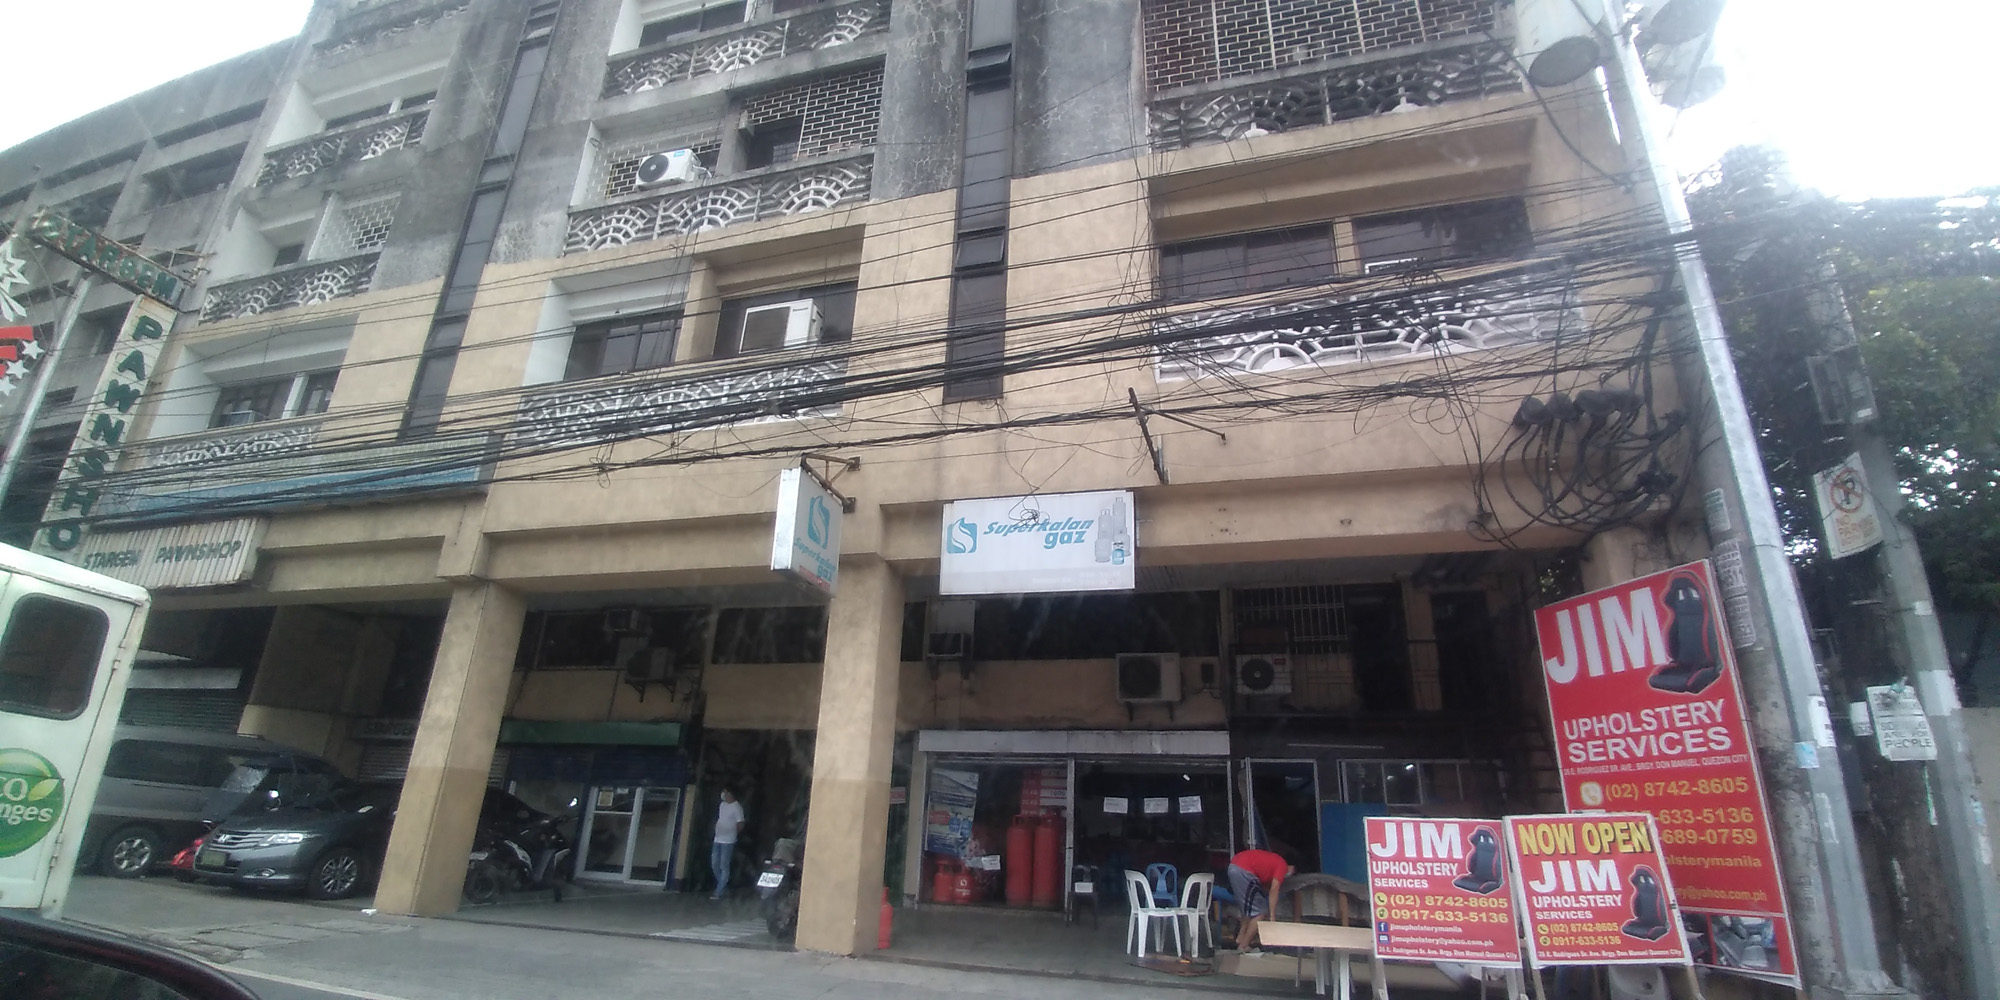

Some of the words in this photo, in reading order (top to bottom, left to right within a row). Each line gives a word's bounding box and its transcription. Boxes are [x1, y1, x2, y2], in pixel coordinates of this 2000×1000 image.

[49, 314, 163, 550] PAWNSHO
[983, 516, 1095, 537] Superkalan
[1043, 528, 1087, 550] gaz
[155, 539, 242, 564] PAWNSHOP
[1545, 586, 1673, 685] JIM
[1562, 698, 1725, 741] UPHOLSTERY
[1568, 726, 1732, 764] SERVICES
[1605, 783, 1639, 801] (02)
[1644, 776, 1749, 797] 8742-8605
[1654, 807, 1754, 825] -633-5136
[1370, 821, 1463, 859] JIM
[1518, 823, 1577, 855] NOW
[1581, 821, 1655, 855] OPEN
[1659, 828, 1758, 845] -689-0759
[1372, 860, 1458, 876] UPHOLSTERY
[1528, 859, 1622, 893] JIM
[1374, 878, 1428, 889] SERVICES
[1390, 894, 1421, 907] (02)
[1425, 895, 1508, 909] 8742-8605
[1531, 894, 1622, 908] UPHOLSTERY
[1391, 909, 1509, 923] 0917-633-5136
[1535, 910, 1593, 920] SERVICES
[1550, 924, 1569, 935] (02)
[1571, 922, 1619, 932] 8742-8605
[1553, 936, 1621, 946] 0917-633-5136
